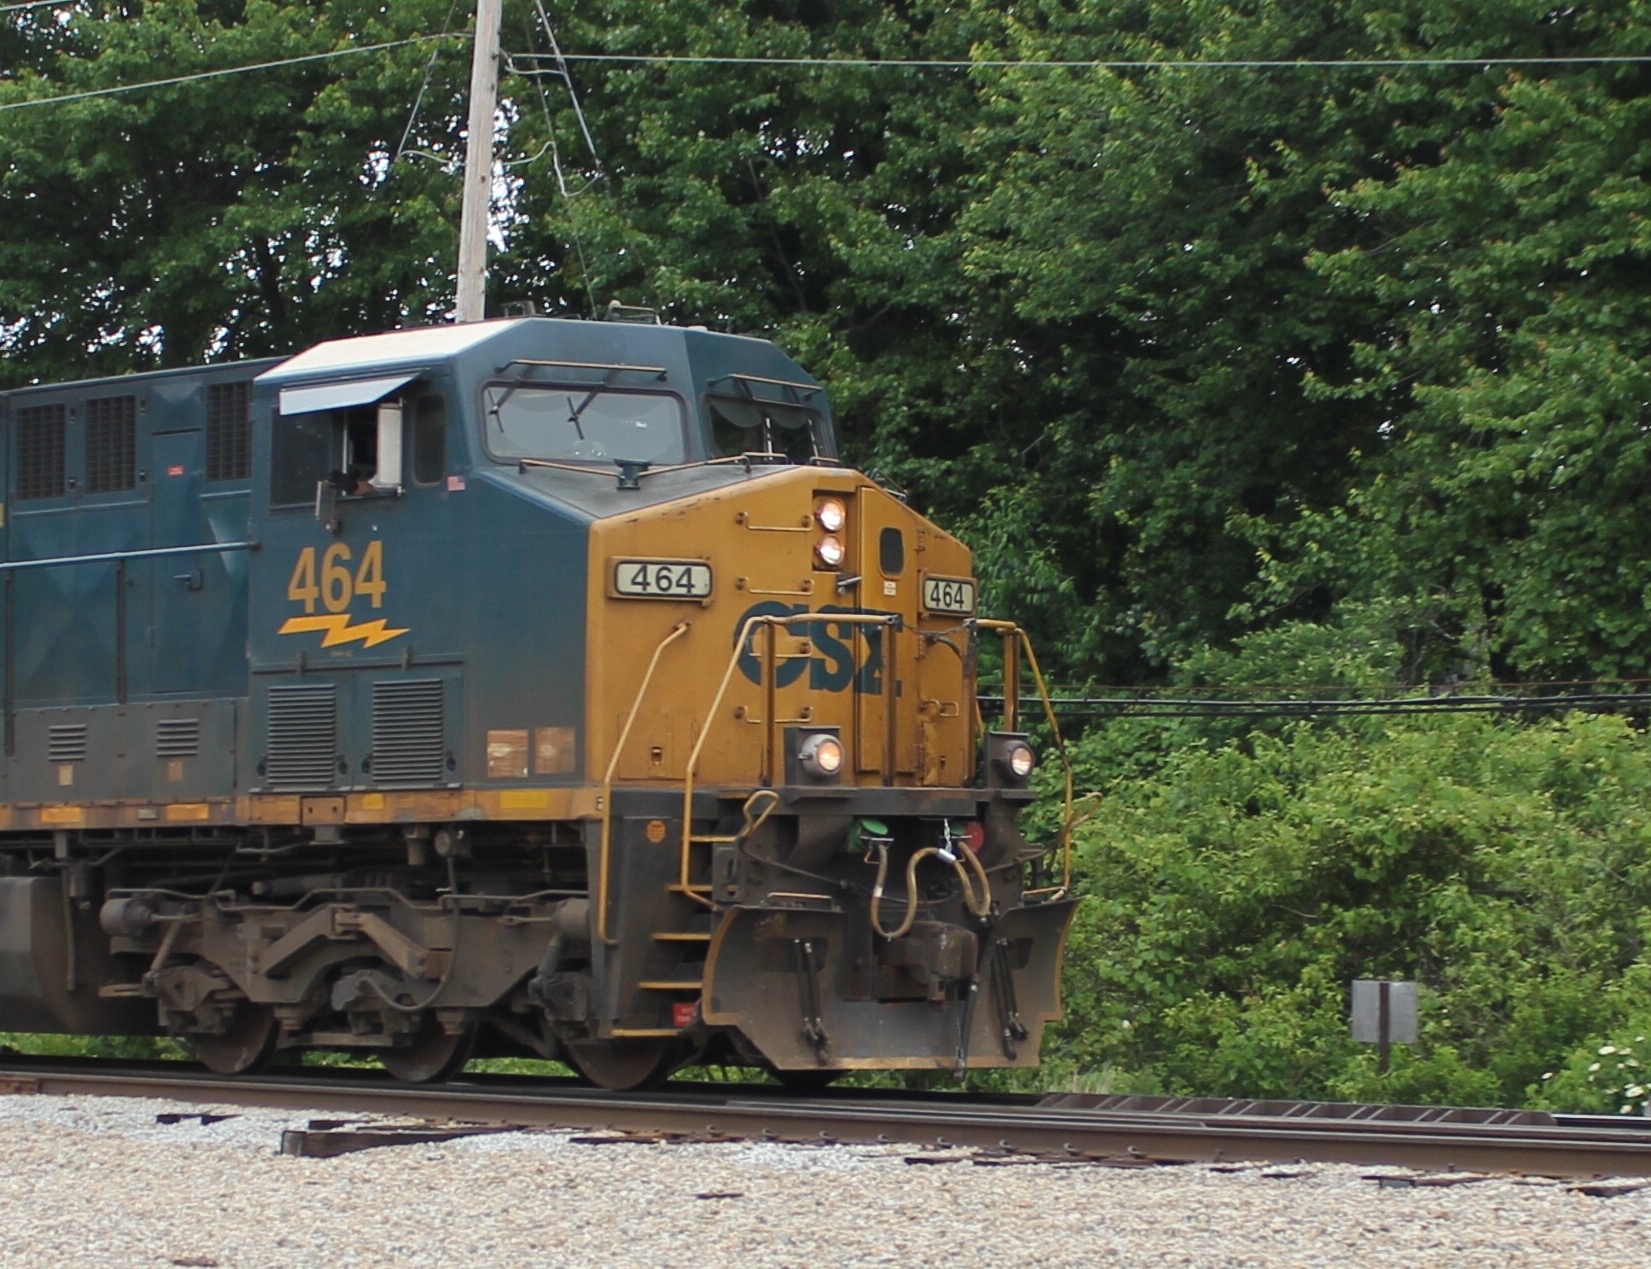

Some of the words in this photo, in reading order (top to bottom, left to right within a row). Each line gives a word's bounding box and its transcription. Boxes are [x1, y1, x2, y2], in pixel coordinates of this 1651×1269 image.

[288, 540, 387, 614] 464
[630, 563, 696, 594] 464
[930, 580, 965, 609] 464
[733, 601, 903, 697] CSX
